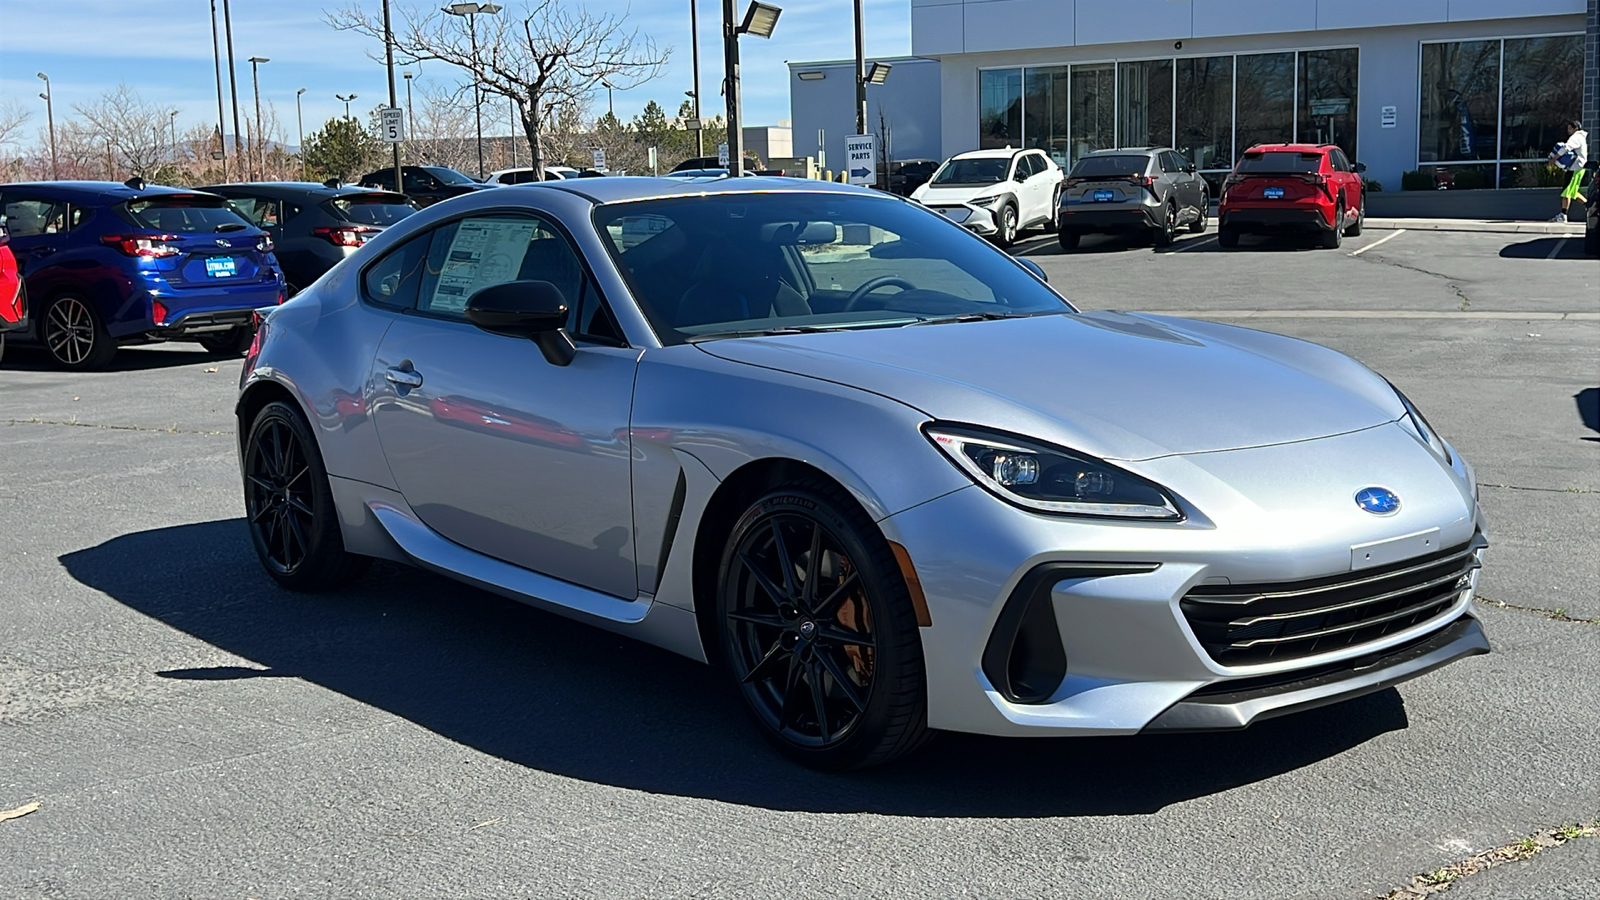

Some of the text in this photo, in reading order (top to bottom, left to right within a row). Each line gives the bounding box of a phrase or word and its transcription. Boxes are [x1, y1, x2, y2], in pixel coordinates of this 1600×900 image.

[389, 126, 398, 139] 5
[848, 142, 873, 151] SERVICE
[851, 152, 870, 160] PARTS
[772, 496, 814, 509] MICHELIN
